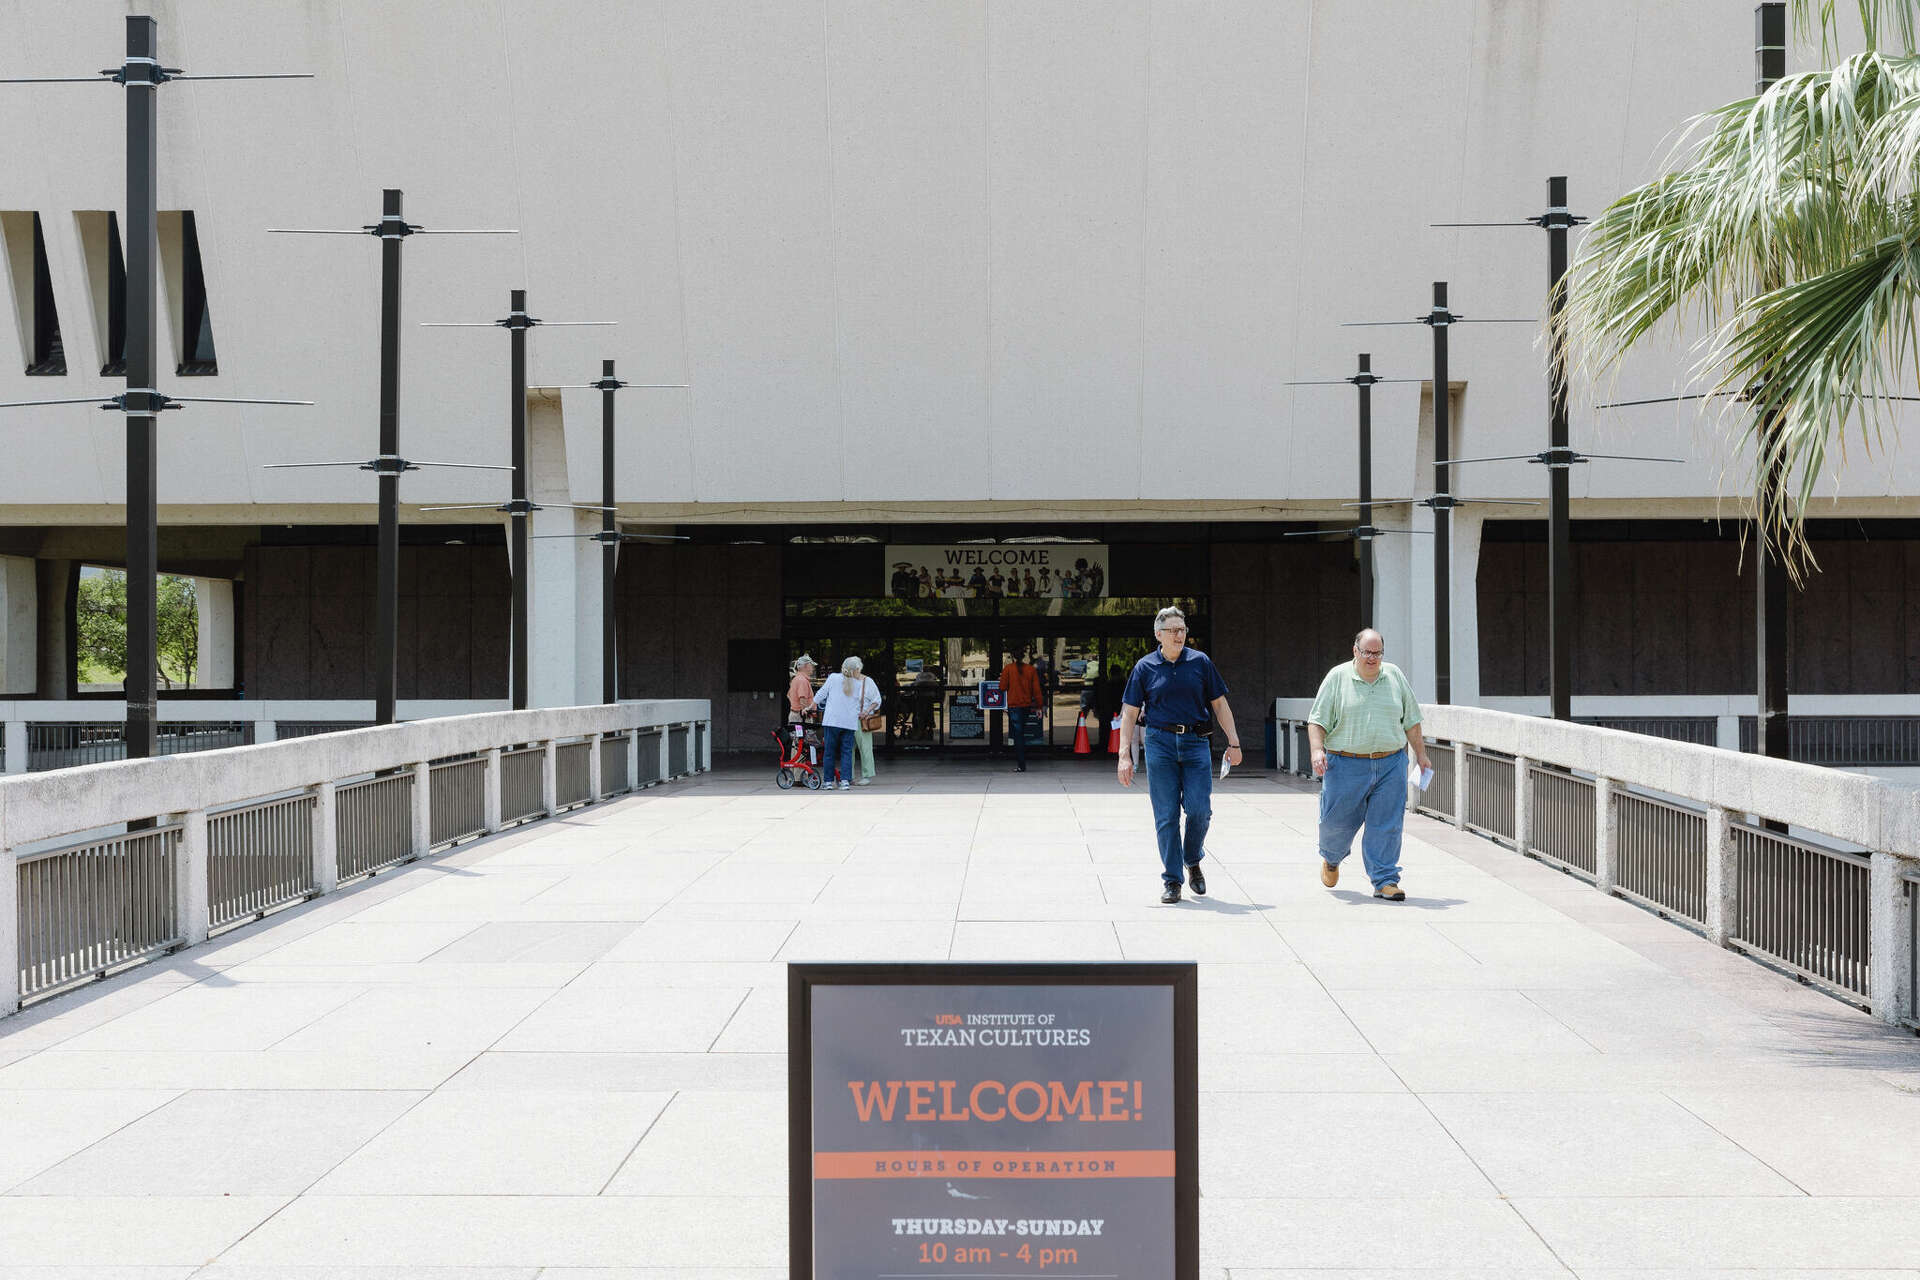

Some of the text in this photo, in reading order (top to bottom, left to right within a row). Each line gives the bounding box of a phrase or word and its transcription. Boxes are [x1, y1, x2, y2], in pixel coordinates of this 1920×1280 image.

[944, 549, 1049, 565] WELCOME
[935, 1014, 1056, 1026] UTSA INSTITUTE OF
[901, 1029, 1091, 1047] TEXAN CULTURES
[848, 1081, 1143, 1122] WELCOME!
[875, 1159, 1117, 1173] HOURS OF OPERATION
[892, 1218, 1105, 1236] THURSDAY-SUNDAY
[918, 1243, 948, 1263] 10
[954, 1247, 992, 1263] am
[1016, 1243, 1032, 1264] 4
[1039, 1247, 1078, 1269] pm
